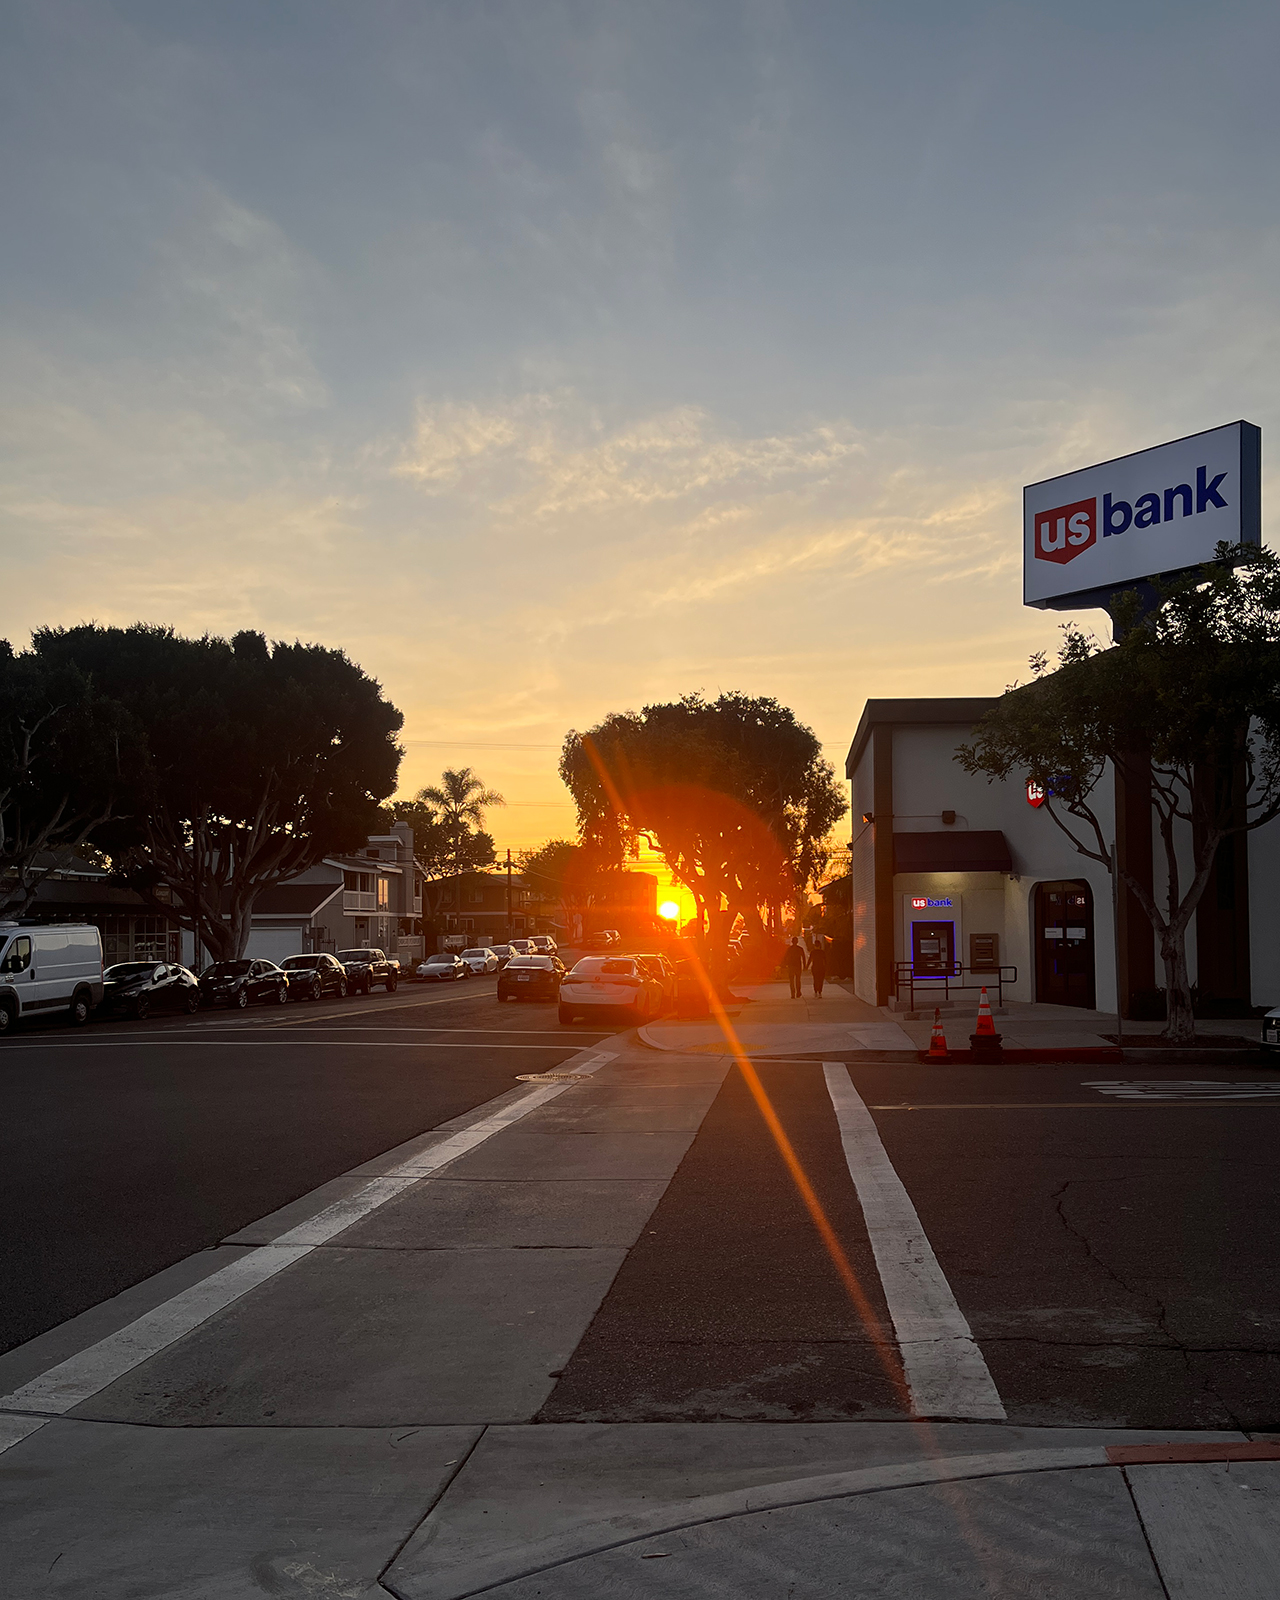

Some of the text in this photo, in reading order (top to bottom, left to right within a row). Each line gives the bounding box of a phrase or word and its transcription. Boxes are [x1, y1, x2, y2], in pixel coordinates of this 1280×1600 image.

[1040, 465, 1229, 553] us bank
[927, 898, 953, 907] bank
